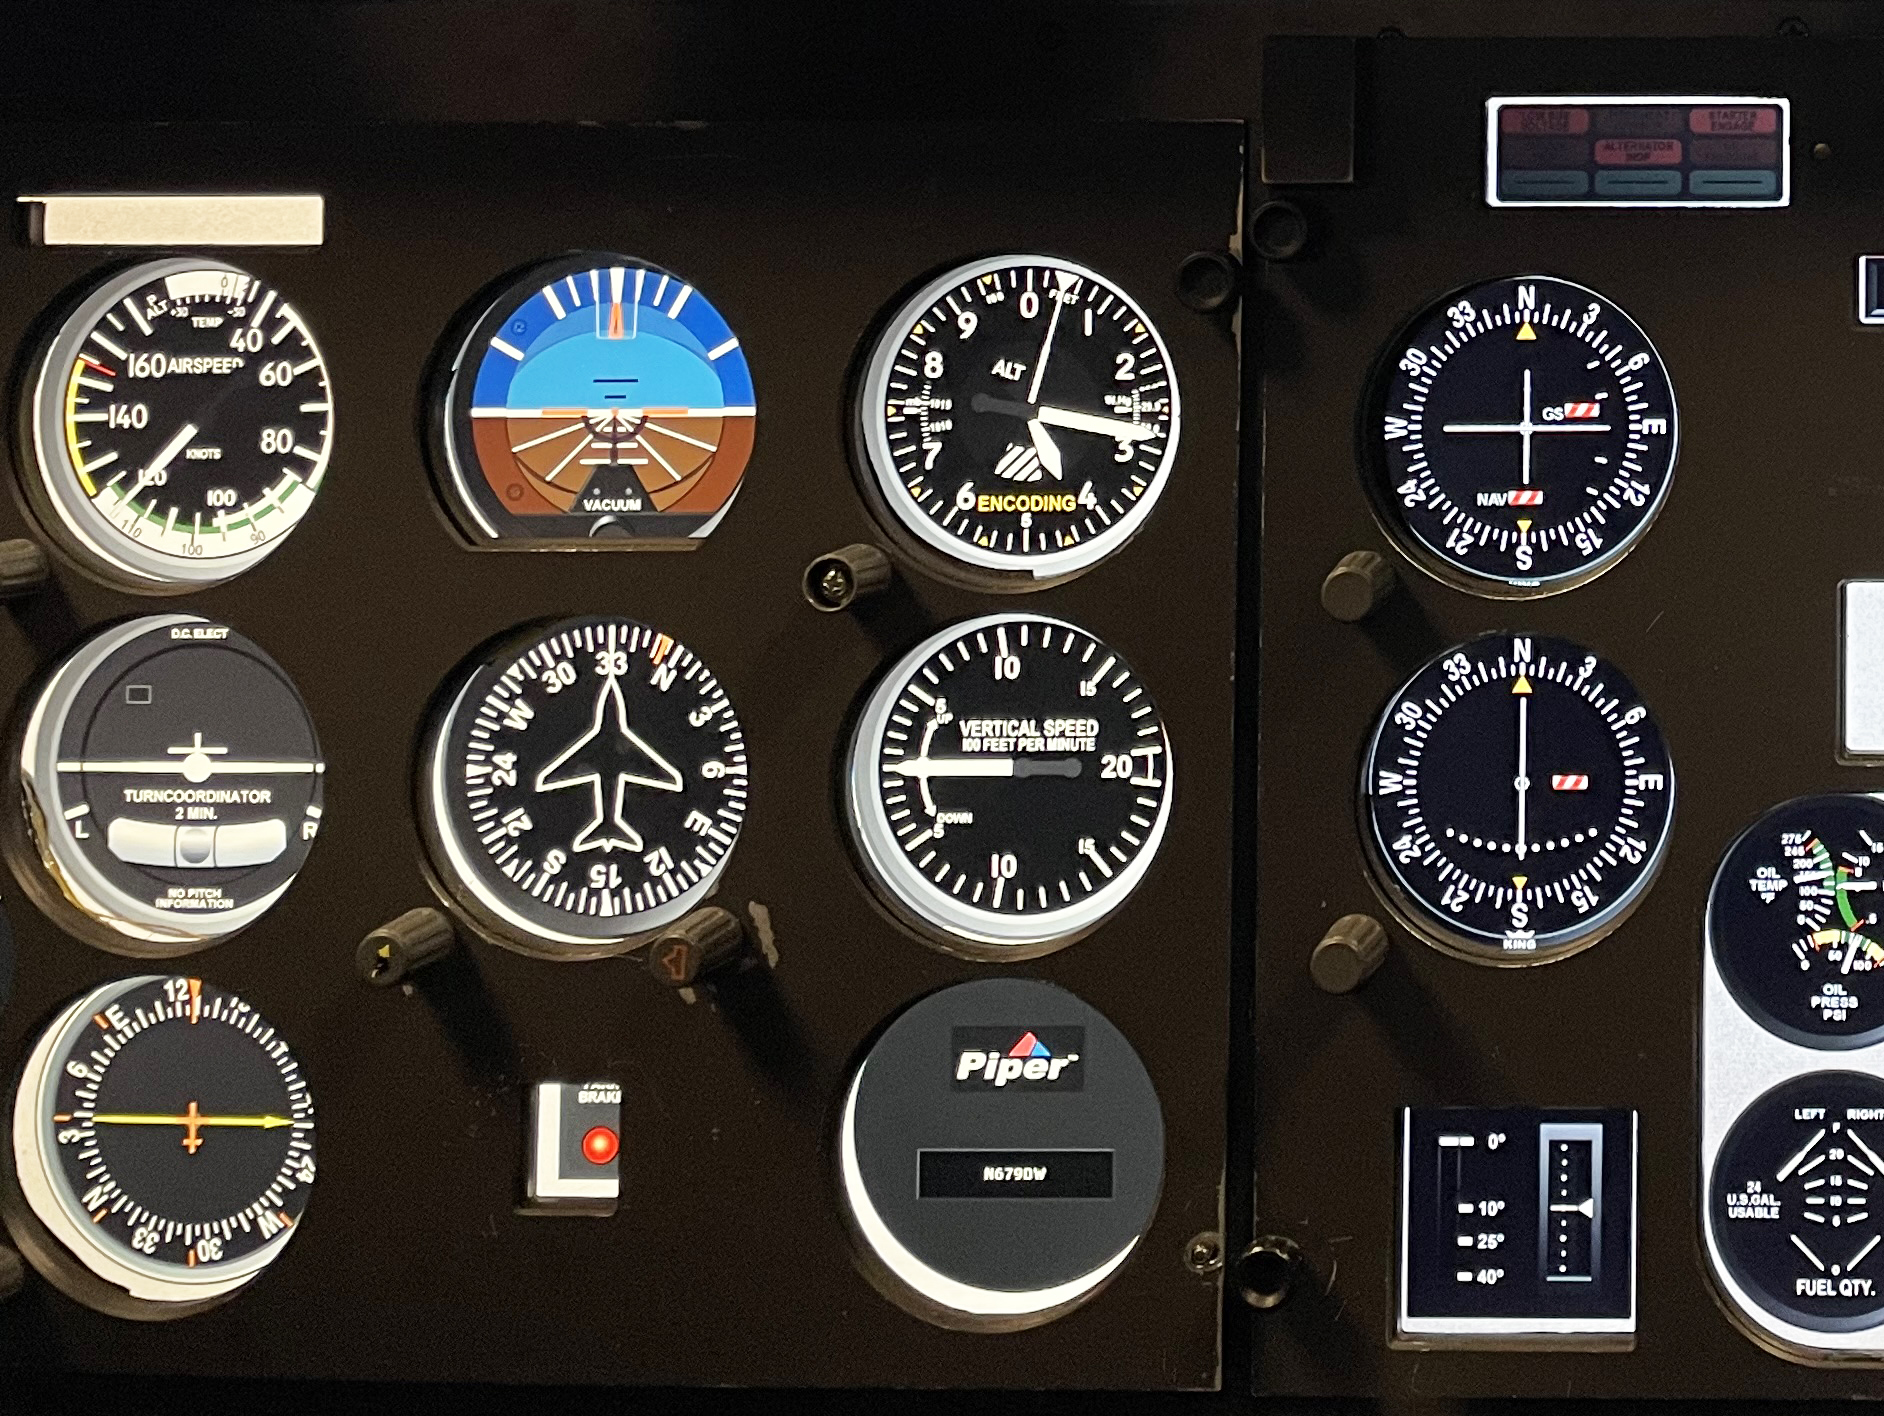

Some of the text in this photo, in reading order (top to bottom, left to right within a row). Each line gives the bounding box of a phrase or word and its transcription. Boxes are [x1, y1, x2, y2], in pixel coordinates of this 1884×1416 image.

[1518, 285, 1535, 309] N
[191, 317, 222, 329] TEMP
[1447, 301, 1476, 328] 33
[230, 329, 262, 352] 40
[129, 354, 167, 377] 160
[259, 362, 294, 386] 60
[992, 360, 1026, 381] ALT
[109, 404, 148, 428] 140
[1542, 408, 1564, 420] GS
[261, 429, 294, 454] 80
[186, 449, 221, 460] KNOTS
[207, 490, 236, 507] 100
[583, 499, 641, 512] VACUUM
[977, 495, 1076, 511] ENCODING
[1477, 493, 1508, 506] NAV
[1516, 545, 1532, 570] S
[1514, 638, 1531, 662] N
[995, 656, 1020, 679] 10
[1443, 653, 1471, 680] 33
[651, 665, 678, 692] N
[937, 713, 953, 724] UP
[960, 719, 1099, 737] VERTICAL SPEED
[1101, 755, 1132, 778] 20
[1379, 770, 1402, 795] W
[124, 790, 271, 803] TURNCOORDINATOR
[175, 808, 217, 820] 2 MIN.
[937, 812, 972, 824] DOWN
[991, 854, 1017, 878] 10
[1757, 867, 1781, 879] OIL
[1749, 880, 1788, 891] TEMP
[1504, 939, 1536, 949] KING
[164, 980, 189, 1002] 12
[1823, 984, 1847, 996] OIL
[1811, 997, 1858, 1008] PRESS
[1823, 1009, 1846, 1021] PSI
[956, 1050, 1069, 1087] Piper
[1795, 1109, 1825, 1120] LEFT
[983, 1166, 1047, 1181] N679DW
[1728, 1207, 1780, 1219] USABLE
[1796, 1279, 1876, 1296] FUEL QTY.
